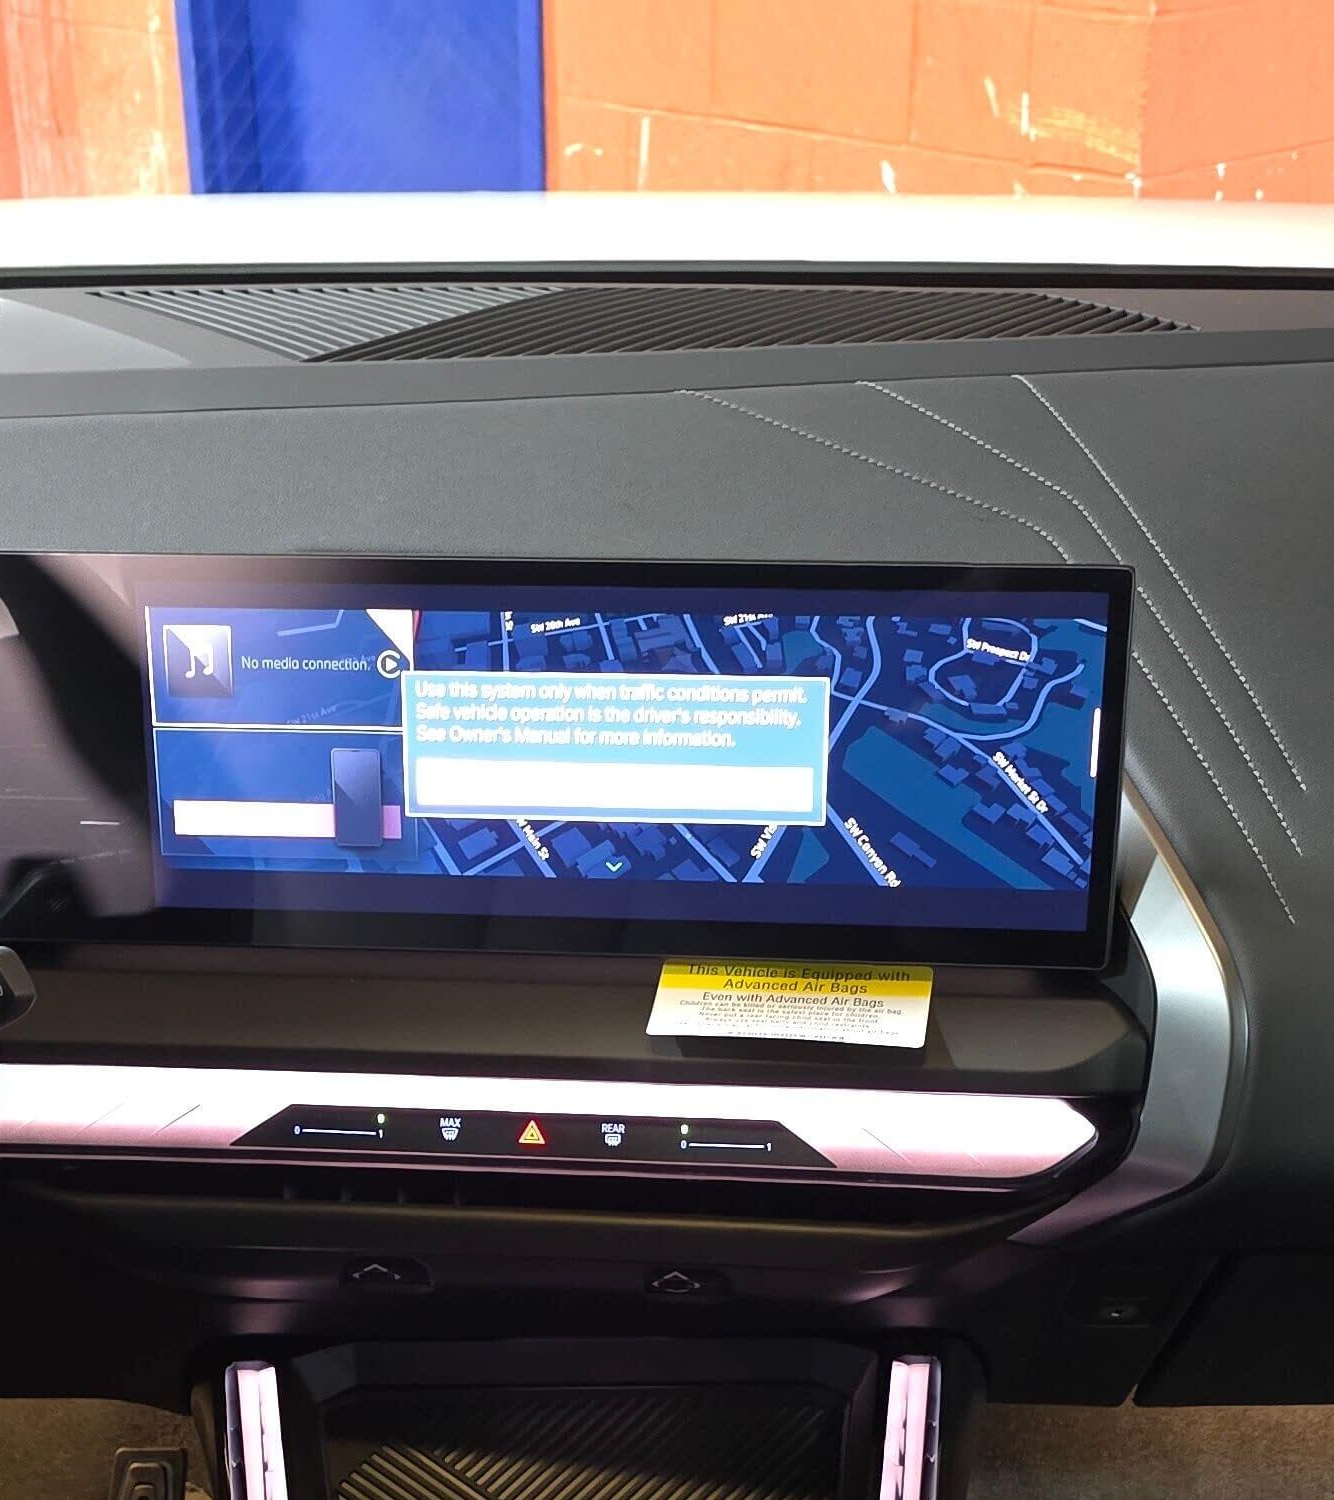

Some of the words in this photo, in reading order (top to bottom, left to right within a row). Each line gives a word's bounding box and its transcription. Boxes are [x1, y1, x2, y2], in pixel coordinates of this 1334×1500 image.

[241, 656, 259, 669] No
[262, 656, 300, 670] media
[302, 656, 371, 671] connection.
[415, 680, 446, 698] Use
[449, 681, 478, 698] this
[480, 682, 536, 702] system
[539, 682, 572, 703] only
[574, 684, 616, 700] when
[620, 683, 664, 701] traffic
[667, 685, 750, 703] conditions
[751, 686, 808, 706] permit.
[415, 702, 451, 720] Safe
[454, 703, 508, 721] vehicle
[510, 705, 584, 724] operation
[588, 705, 602, 723] is
[604, 705, 631, 723] the
[633, 707, 691, 725] driver's
[693, 709, 802, 729] responsibility.
[416, 723, 447, 742] See
[449, 725, 512, 743] Owner's
[514, 726, 570, 745] Manual
[573, 727, 598, 746] for
[599, 730, 641, 746] more
[643, 728, 736, 748] information.
[993, 751, 1009, 768] SW
[750, 837, 767, 859] SW
[844, 817, 864, 838] SW
[857, 834, 888, 875] Canyon
[884, 870, 902, 888] Rd
[689, 963, 718, 976] This
[724, 965, 778, 978] Vehicle
[783, 967, 796, 979] is
[801, 968, 872, 982] Equipped
[878, 970, 910, 982] with
[723, 978, 798, 992] Advanced
[803, 981, 826, 992] Air
[830, 982, 868, 995] Bags
[702, 991, 732, 1002] Even
[736, 993, 763, 1003] with
[765, 993, 828, 1005] Advanced
[830, 996, 849, 1006] Air
[853, 997, 884, 1009] Bags
[439, 1117, 462, 1128] MAX
[601, 1123, 626, 1134] REAR
